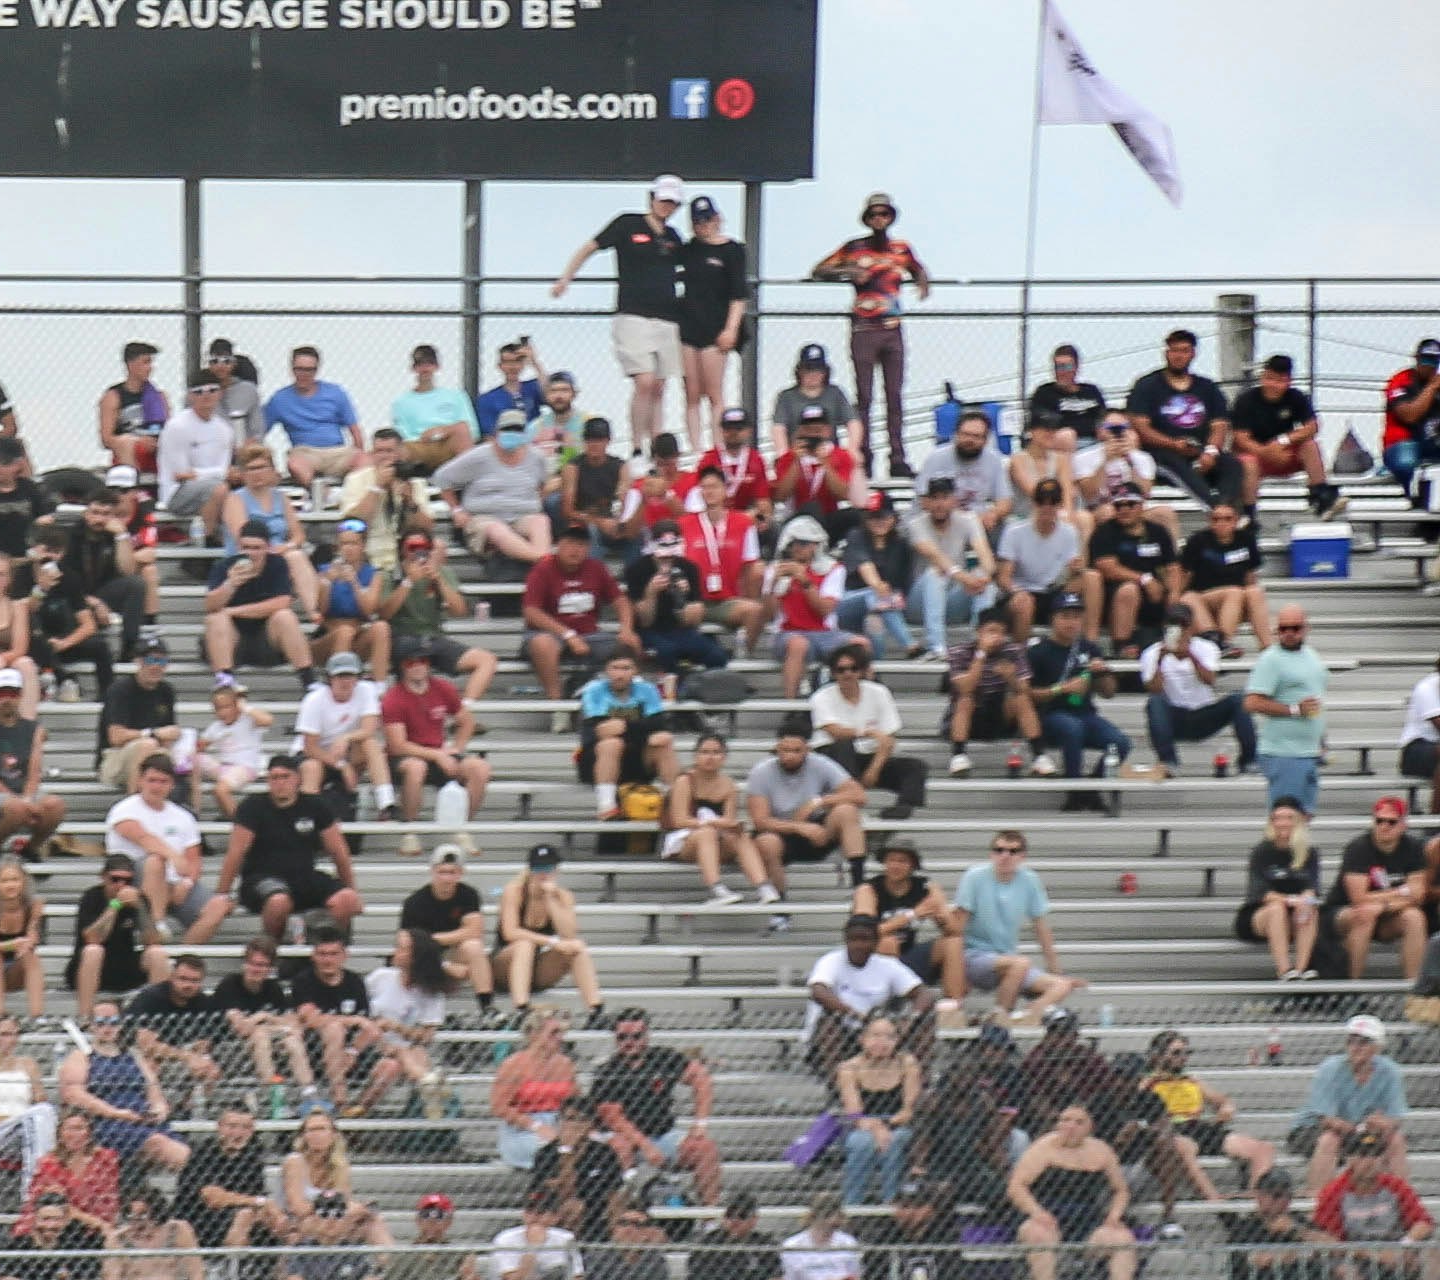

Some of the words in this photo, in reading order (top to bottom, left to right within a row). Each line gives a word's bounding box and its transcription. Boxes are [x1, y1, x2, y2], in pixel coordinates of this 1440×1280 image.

[32, 0, 121, 28] WAY
[136, 0, 328, 29] SAUSAGE
[340, 0, 510, 29] SHOULD
[340, 86, 658, 126] premiofoods.com
